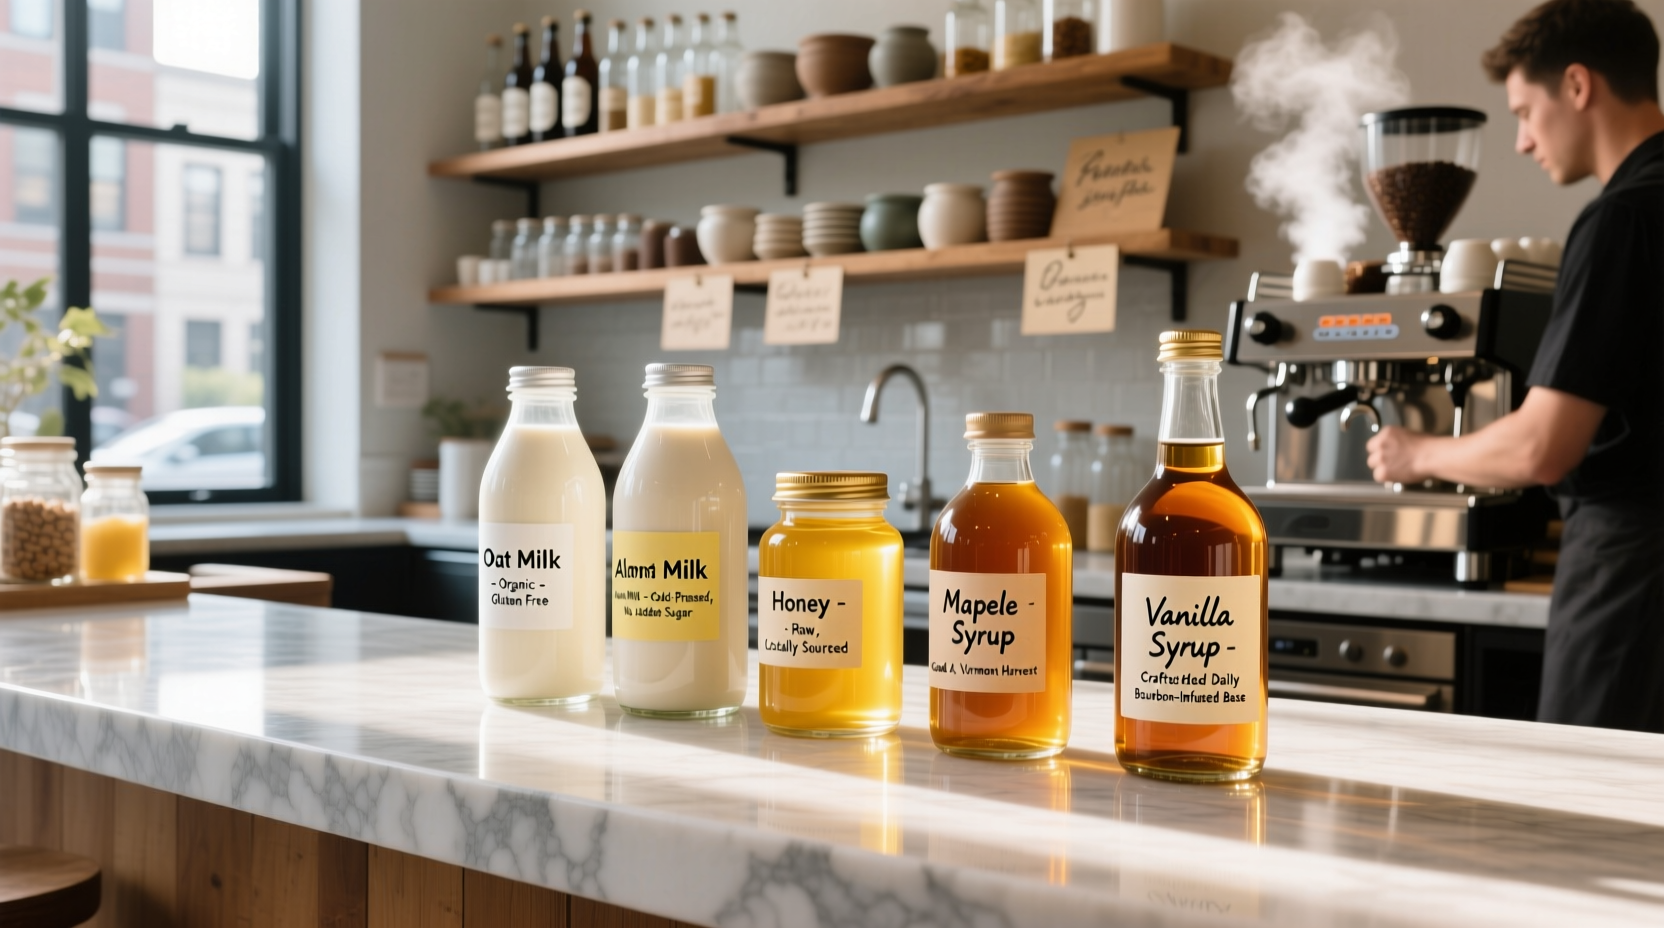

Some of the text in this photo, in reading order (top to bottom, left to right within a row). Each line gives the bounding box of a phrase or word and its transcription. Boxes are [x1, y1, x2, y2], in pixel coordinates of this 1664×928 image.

[483, 547, 562, 570] Oat Milk
[663, 558, 709, 580] Milk
[772, 590, 831, 620] Honey
[943, 588, 1019, 624] Mapele
[1145, 595, 1235, 628] Vanilla
[951, 619, 1016, 655] Syrup
[1148, 630, 1221, 670] Syrup
